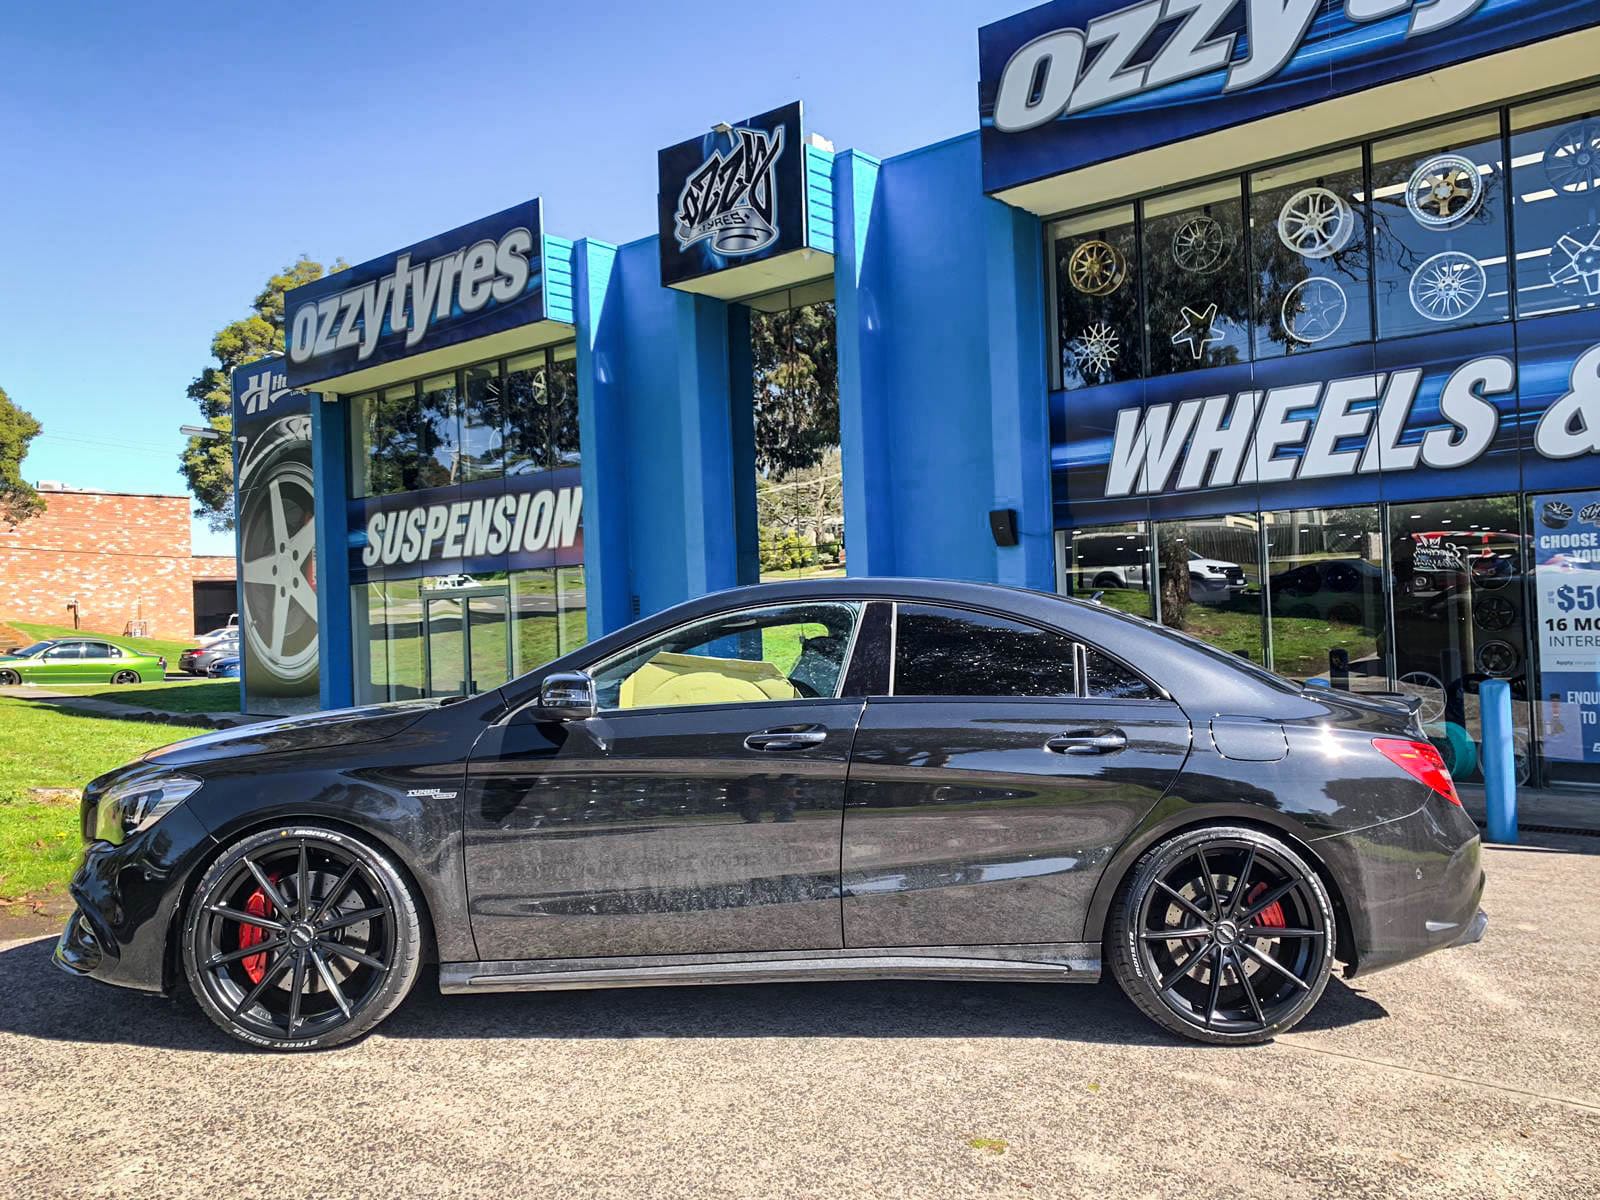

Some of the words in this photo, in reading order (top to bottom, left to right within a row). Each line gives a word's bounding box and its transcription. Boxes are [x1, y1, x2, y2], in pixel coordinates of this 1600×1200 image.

[701, 211, 747, 233] TYRES
[1103, 355, 1516, 498] WHEELS
[1533, 342, 1600, 459] &
[362, 486, 583, 567] SUSPENSION
[1540, 532, 1598, 549] CHOOSE
[1545, 618, 1568, 631] 16
[1581, 711, 1597, 725] TO
[273, 1039, 318, 1049] STREET
